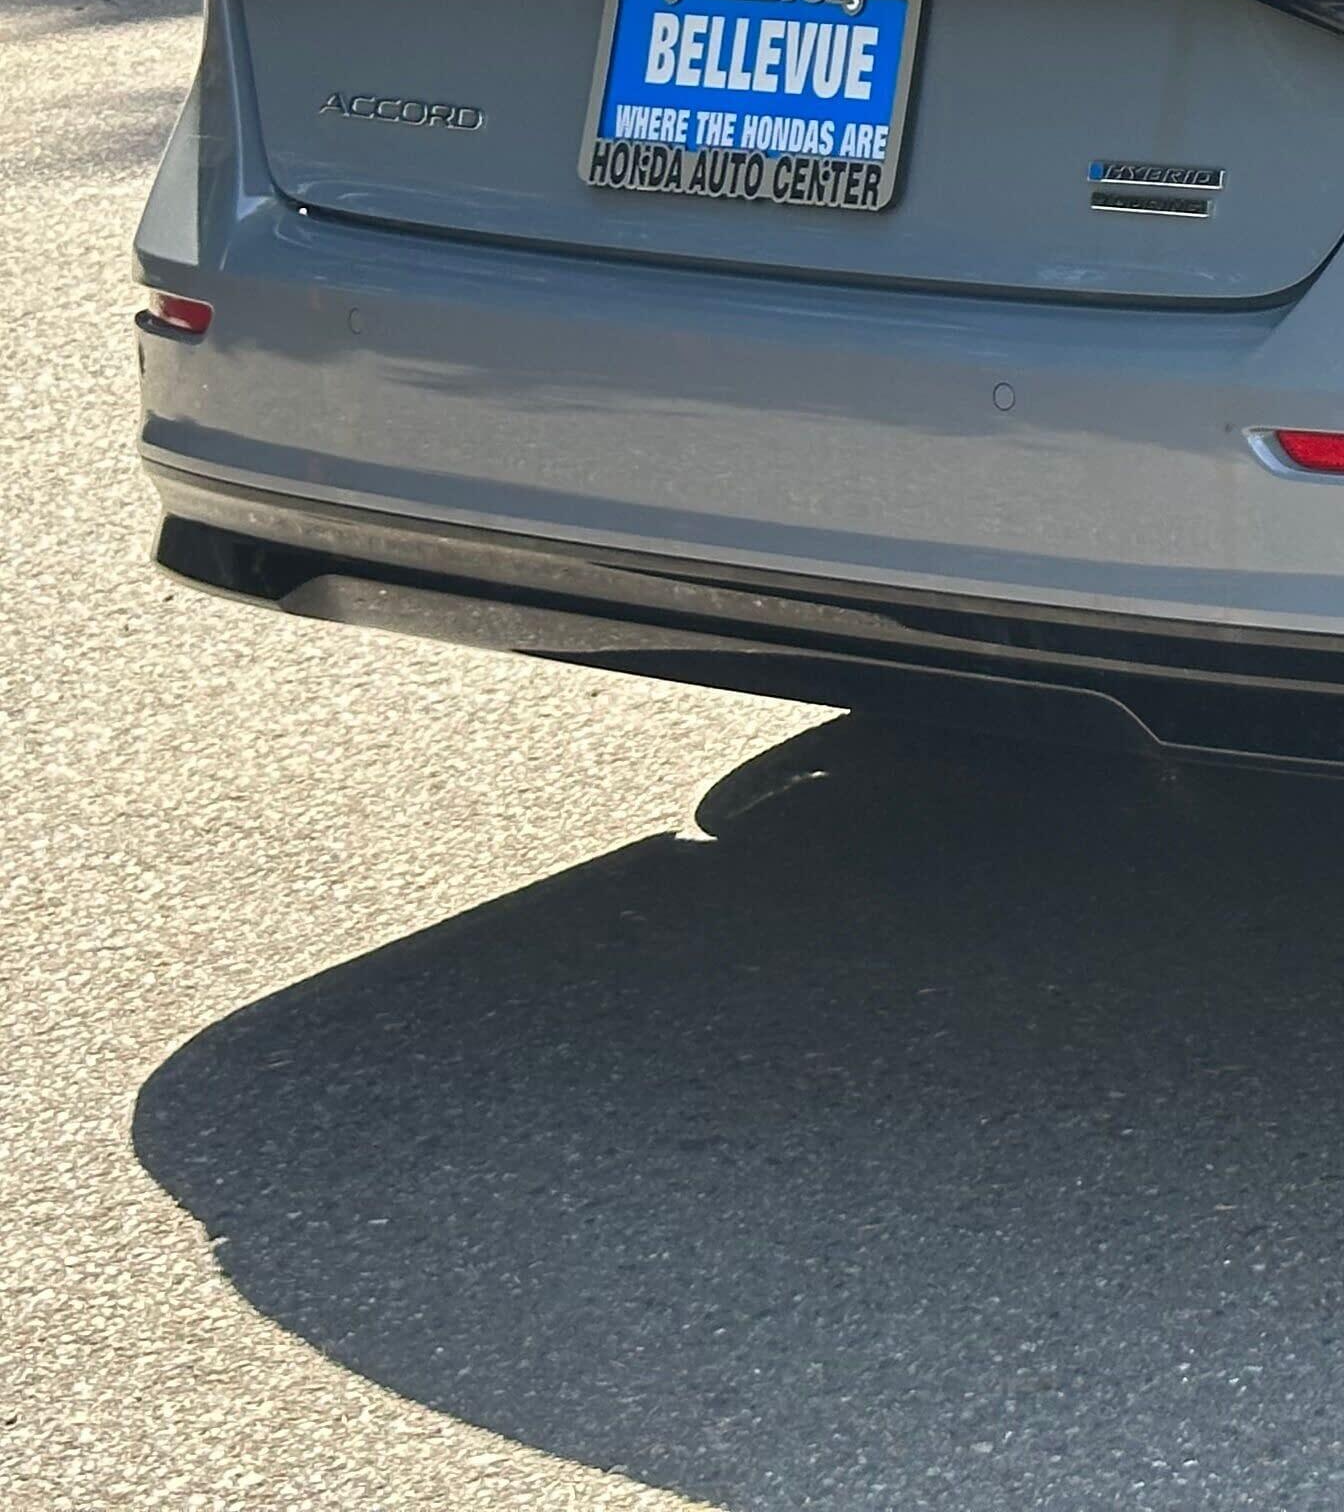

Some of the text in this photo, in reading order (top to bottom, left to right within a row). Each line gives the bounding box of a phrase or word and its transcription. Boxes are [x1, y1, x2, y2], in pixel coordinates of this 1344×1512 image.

[644, 11, 880, 101] BELLEVUE
[319, 91, 486, 131] ACCORD
[614, 104, 890, 160] WHERE THE HONDAS ARE
[588, 141, 883, 209] HONDA AUTO CENTER
[1104, 164, 1213, 184] HYBRID
